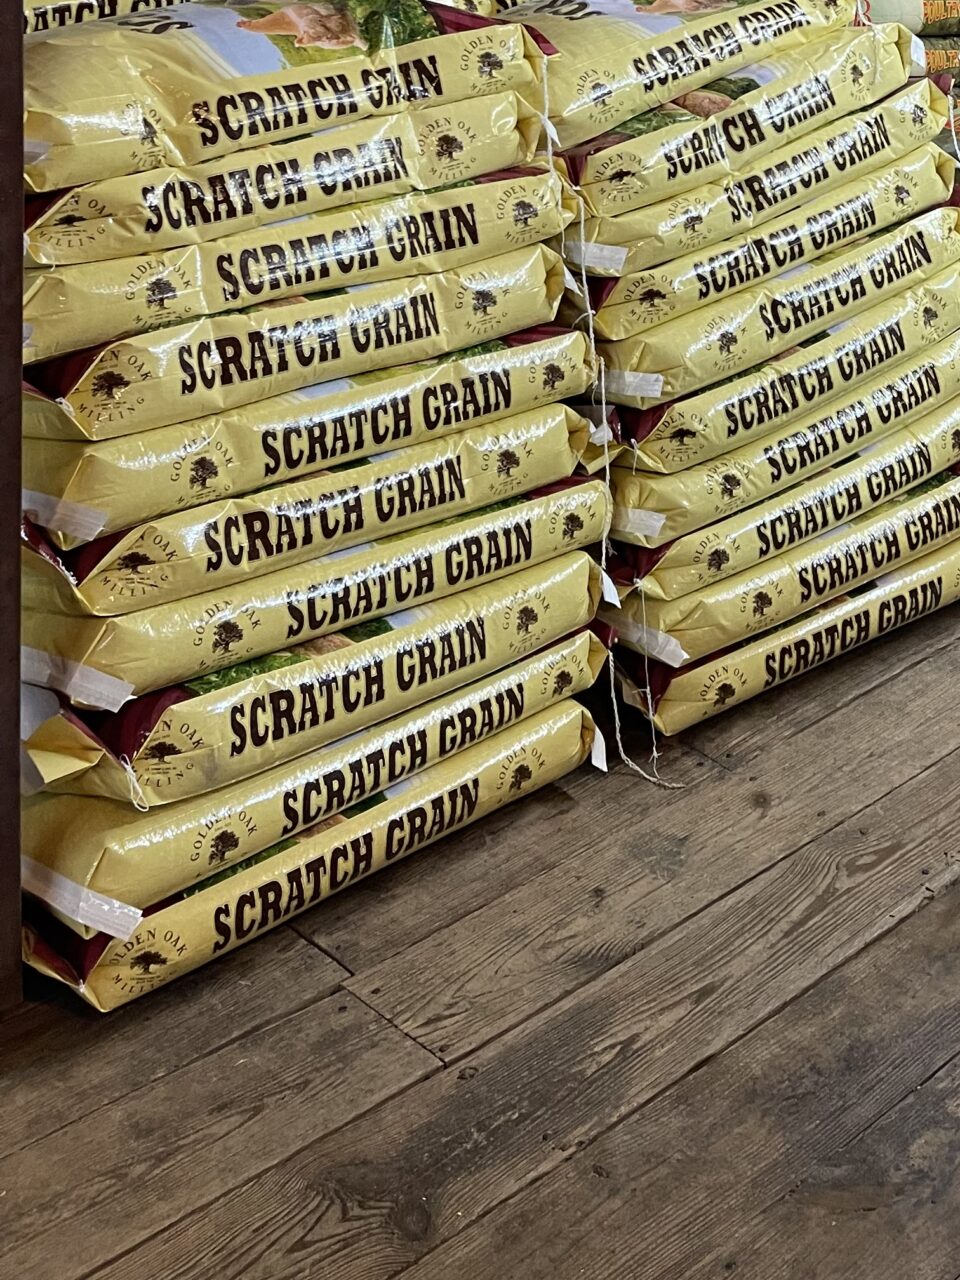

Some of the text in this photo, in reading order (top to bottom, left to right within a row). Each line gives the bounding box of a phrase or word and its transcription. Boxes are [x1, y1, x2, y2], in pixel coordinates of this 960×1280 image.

[191, 54, 444, 147] SCRATCH GRAIN
[460, 34, 494, 72] GOLDEN
[457, 120, 478, 144] OAK
[662, 108, 766, 181] SCRATCH
[724, 113, 892, 224] SCRATCH GRAIN
[142, 136, 410, 233] SCRATCH GRAIN
[496, 184, 527, 221] GOLDEN
[37, 226, 106, 248] MILLING
[125, 257, 167, 301] GOLDEN
[216, 203, 480, 303] SCRATCH GRAIN
[693, 194, 877, 301] SCRATCH GRAIN
[759, 230, 932, 342] SCRATCH GRAIN
[128, 354, 153, 381] OAK
[179, 292, 440, 396] SCRATCH GRAIN
[725, 321, 906, 438] SCRATCH GRAIN
[216, 440, 235, 468] OAK
[261, 369, 512, 478] SCRATCH GRAIN
[764, 362, 941, 484] SCRATCH GRAIN
[205, 455, 466, 572] SCRATCH GRAIN
[756, 441, 932, 559] SCRATCH GRAIN
[153, 535, 179, 561] OAK
[286, 519, 532, 640] SCRATCH GRAIN
[799, 527, 899, 605] SCRATCH
[733, 669, 748, 688] OAK
[764, 576, 943, 688] SCRATCH GRAIN
[230, 616, 486, 757] SCRATCH GRAIN
[179, 722, 205, 749] OAK
[281, 682, 525, 837] SCRATCH GRAIN
[532, 745, 547, 770] OAK
[213, 777, 480, 954] SCRATCH GRAIN
[238, 810, 258, 837] OAK
[163, 930, 188, 957] OAK
